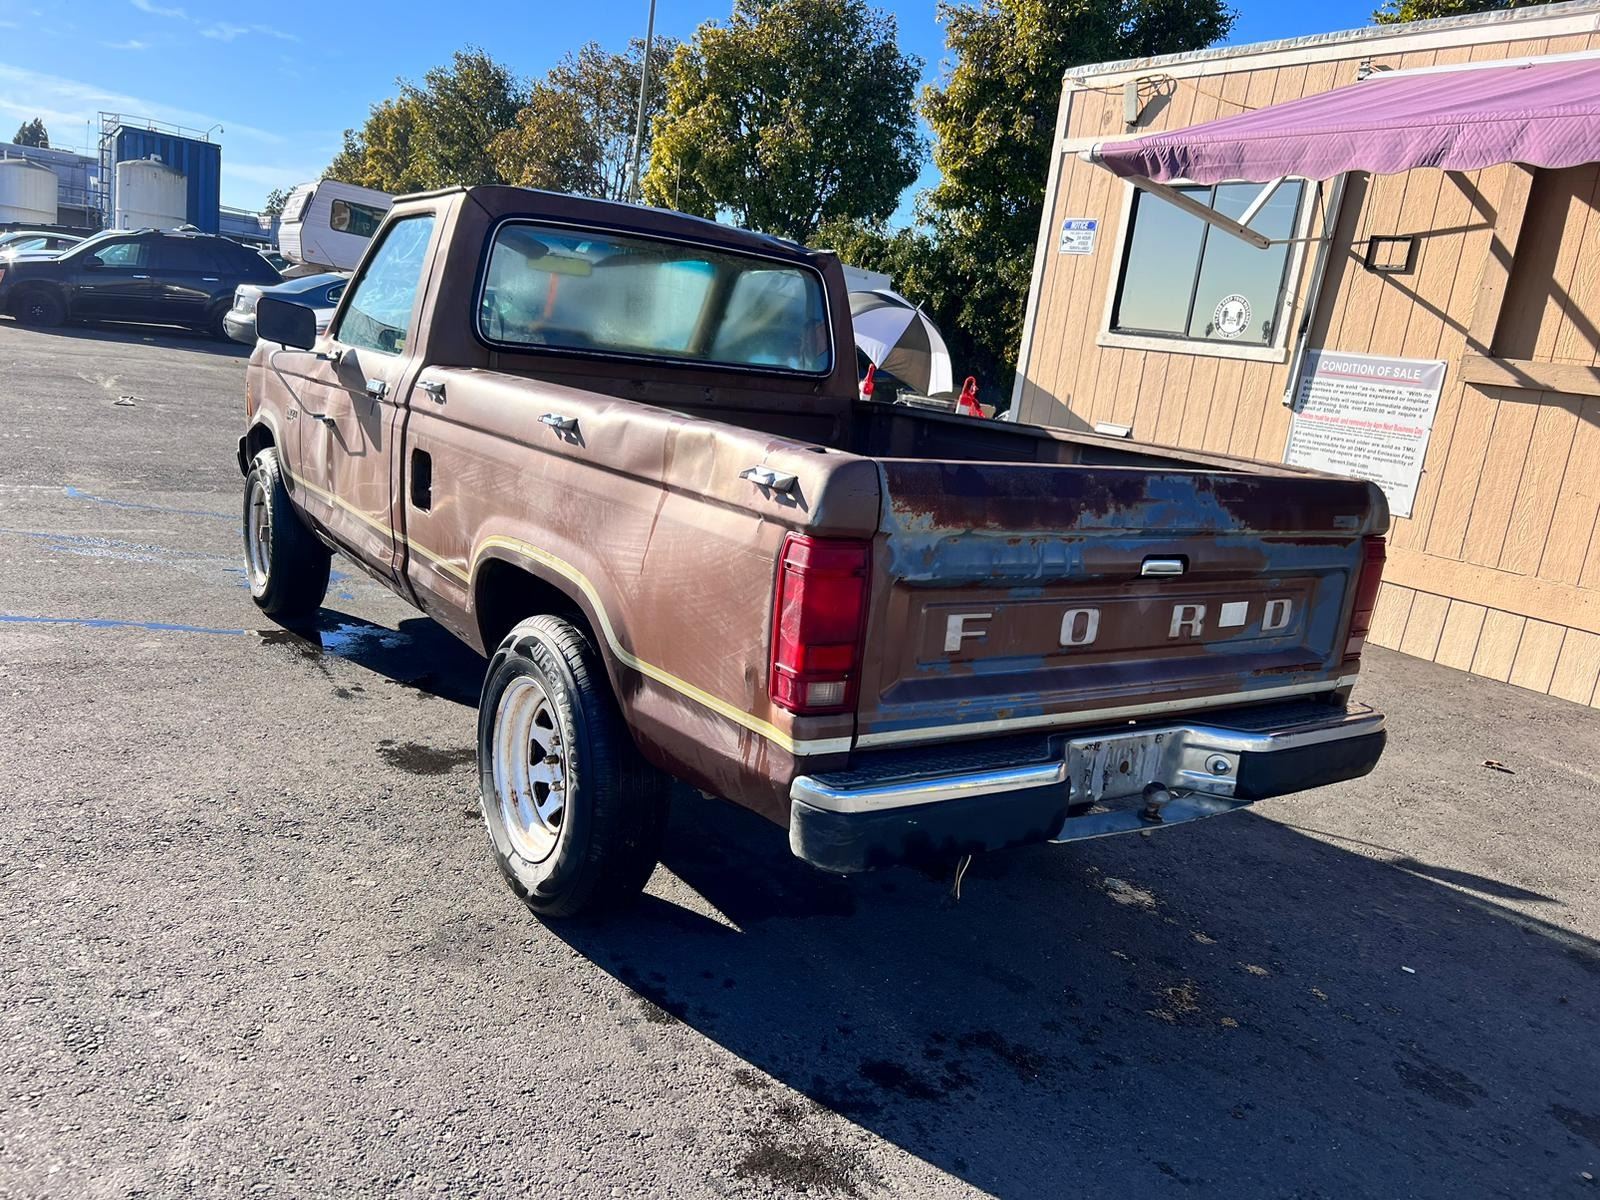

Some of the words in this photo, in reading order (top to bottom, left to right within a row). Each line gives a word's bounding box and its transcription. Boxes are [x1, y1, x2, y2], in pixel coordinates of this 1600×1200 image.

[1321, 360, 1375, 375] CONDITION
[1377, 366, 1391, 376] OF
[1393, 367, 1421, 379] SALE
[1369, 393, 1398, 401] expressed
[1312, 440, 1339, 448] responsible
[1372, 456, 1406, 466] responsibility
